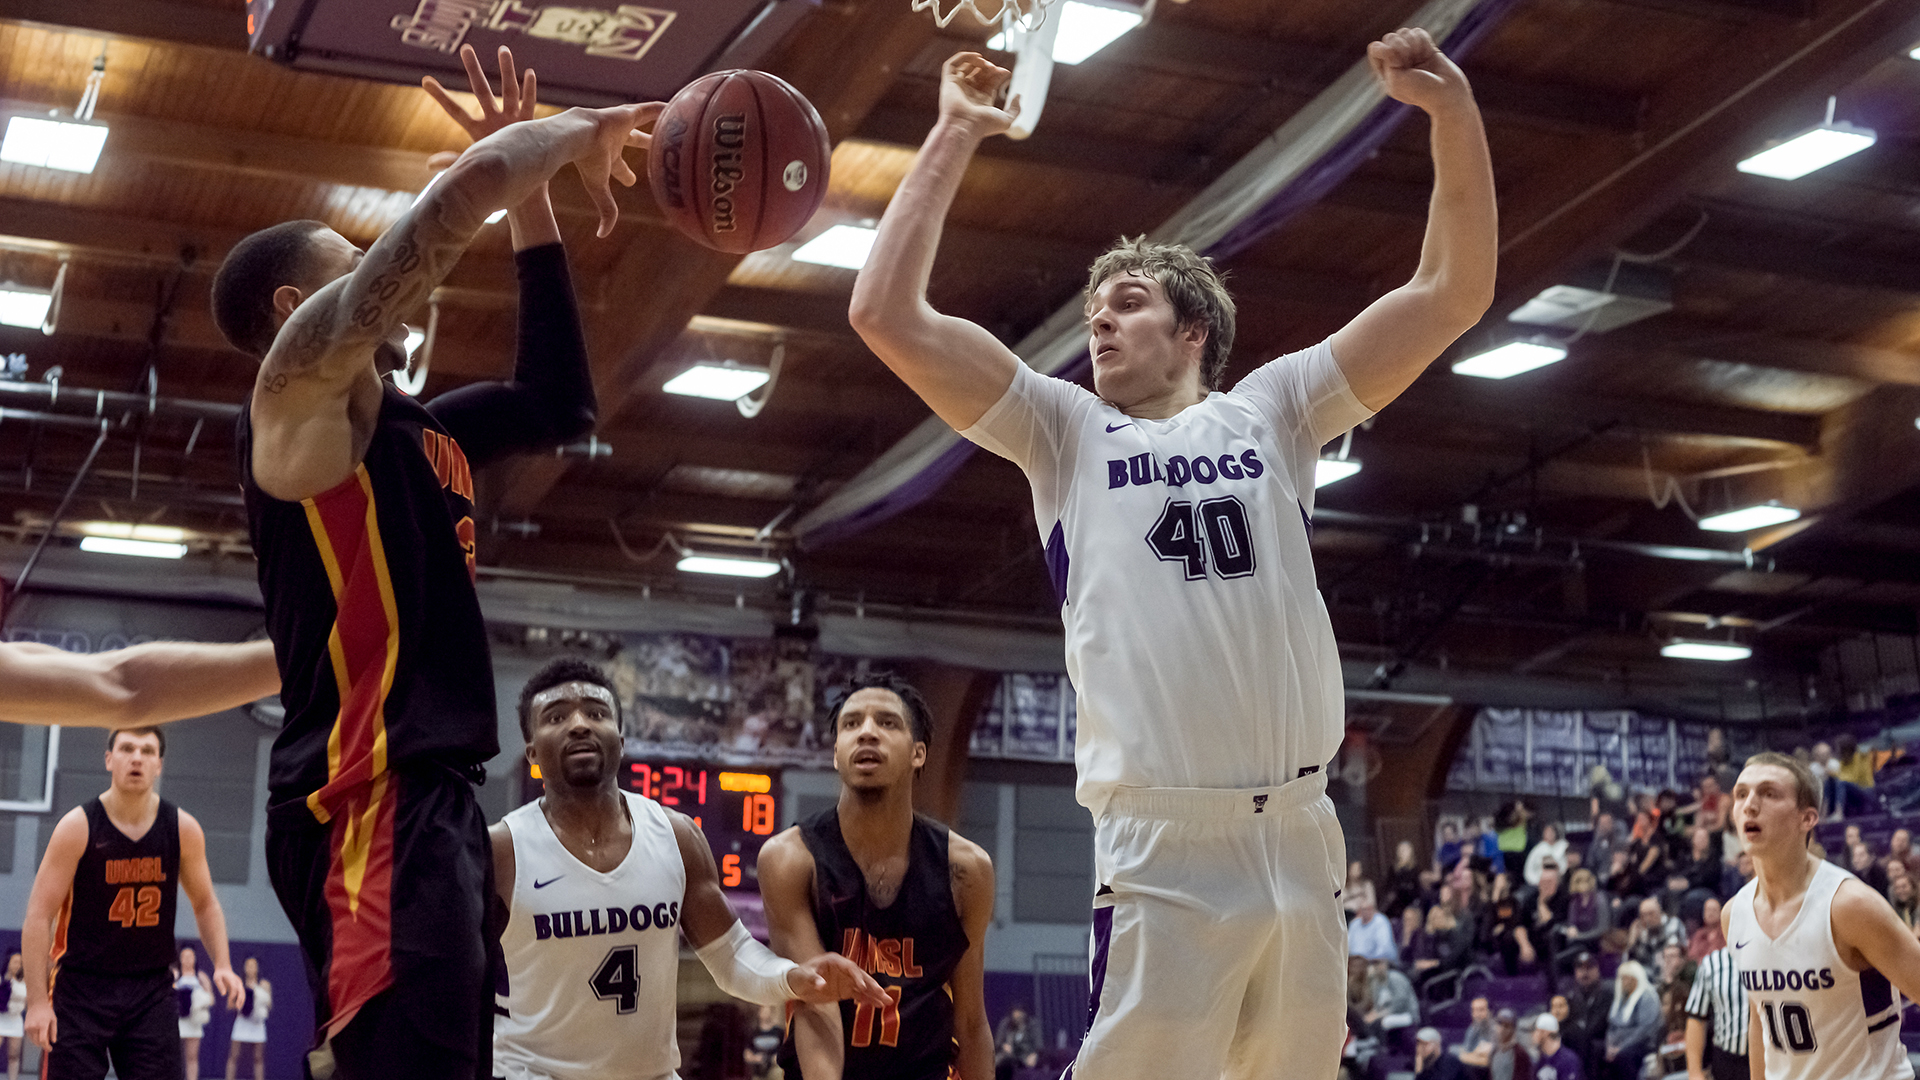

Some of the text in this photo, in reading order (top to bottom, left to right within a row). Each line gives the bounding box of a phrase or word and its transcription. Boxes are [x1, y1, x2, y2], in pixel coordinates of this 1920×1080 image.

[712, 112, 746, 233] Wilson
[1144, 495, 1257, 582] 40
[631, 763, 707, 806] 3:24
[742, 794, 775, 836] 18
[105, 857, 166, 885] UMSL
[722, 854, 742, 887] 5
[108, 886, 161, 928] 42
[533, 901, 678, 940] BULLDOGS
[588, 944, 641, 1015] 4
[1739, 968, 1835, 991] ULLDOGS
[1761, 1001, 1818, 1056] 10
